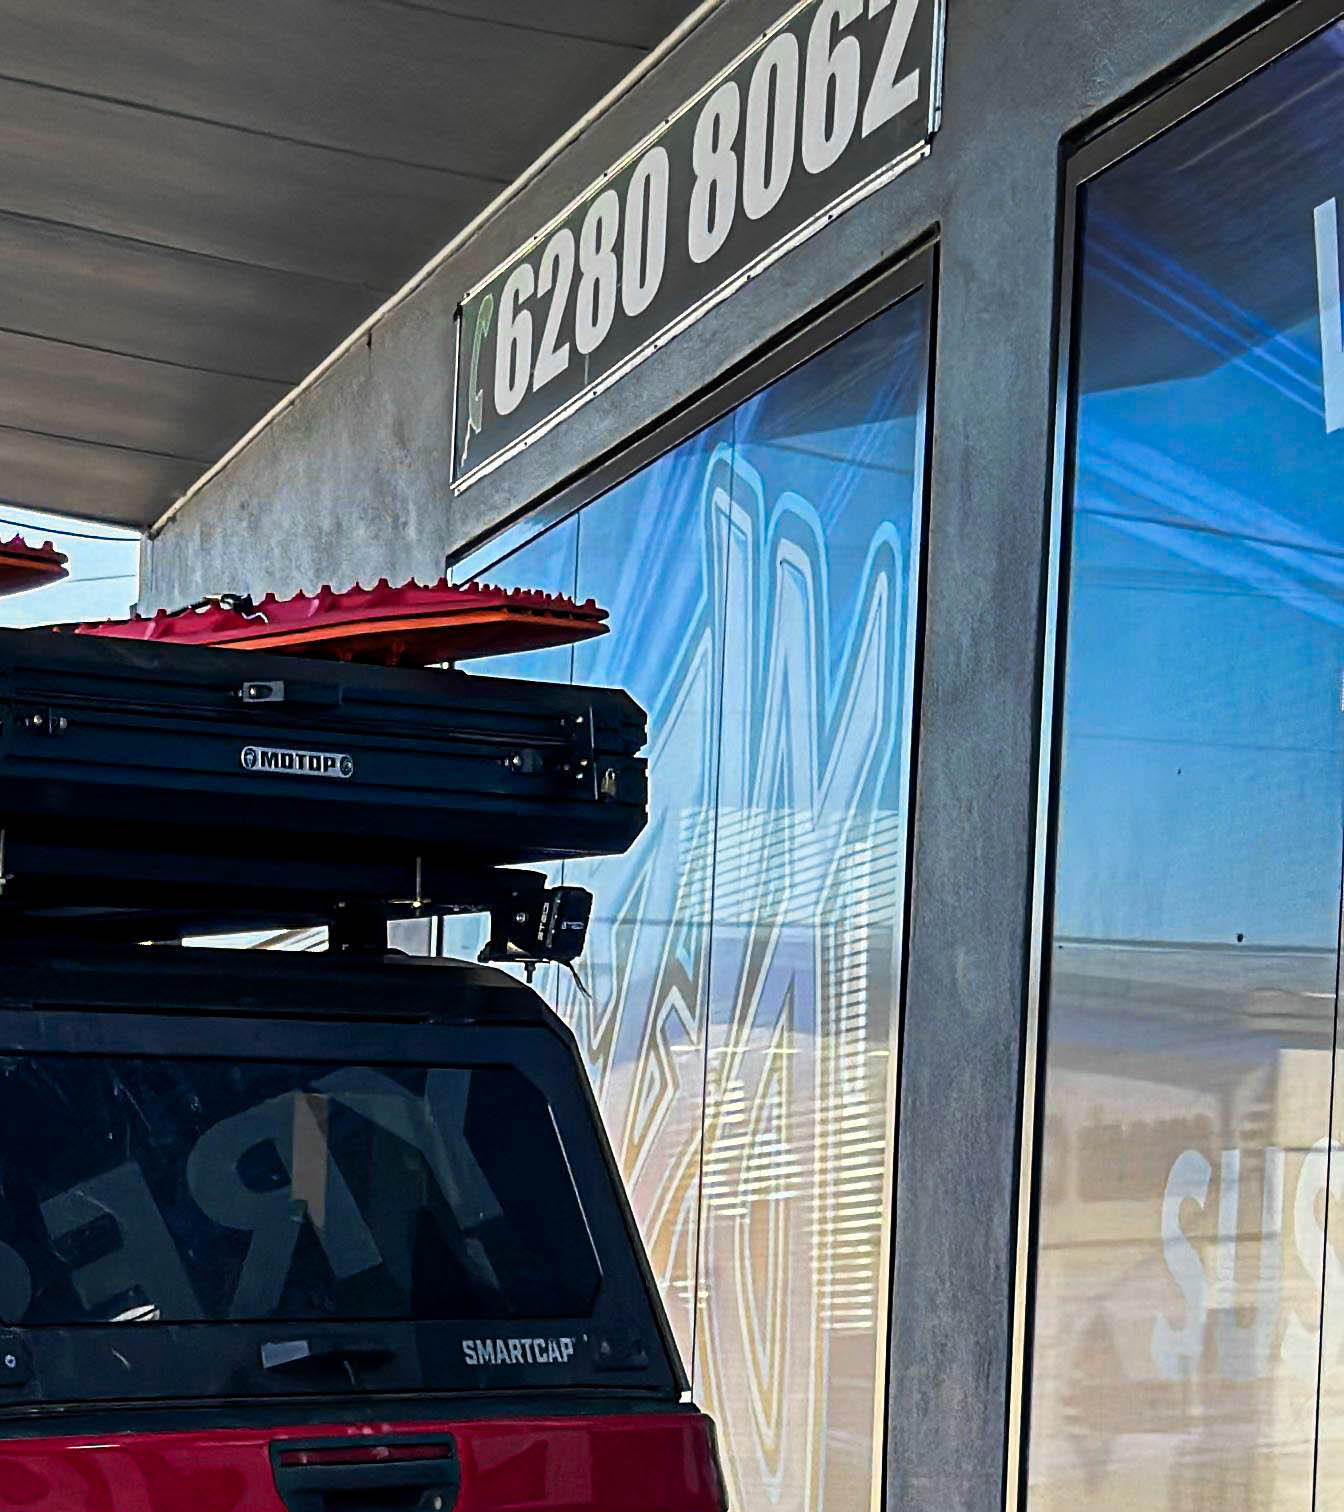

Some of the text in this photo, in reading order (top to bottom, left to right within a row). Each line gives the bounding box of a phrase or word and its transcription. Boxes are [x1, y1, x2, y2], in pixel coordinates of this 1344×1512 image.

[494, 0, 920, 416] 6280 8062
[261, 751, 337, 773] MOTOP
[462, 1338, 574, 1365] SMARTCAP
